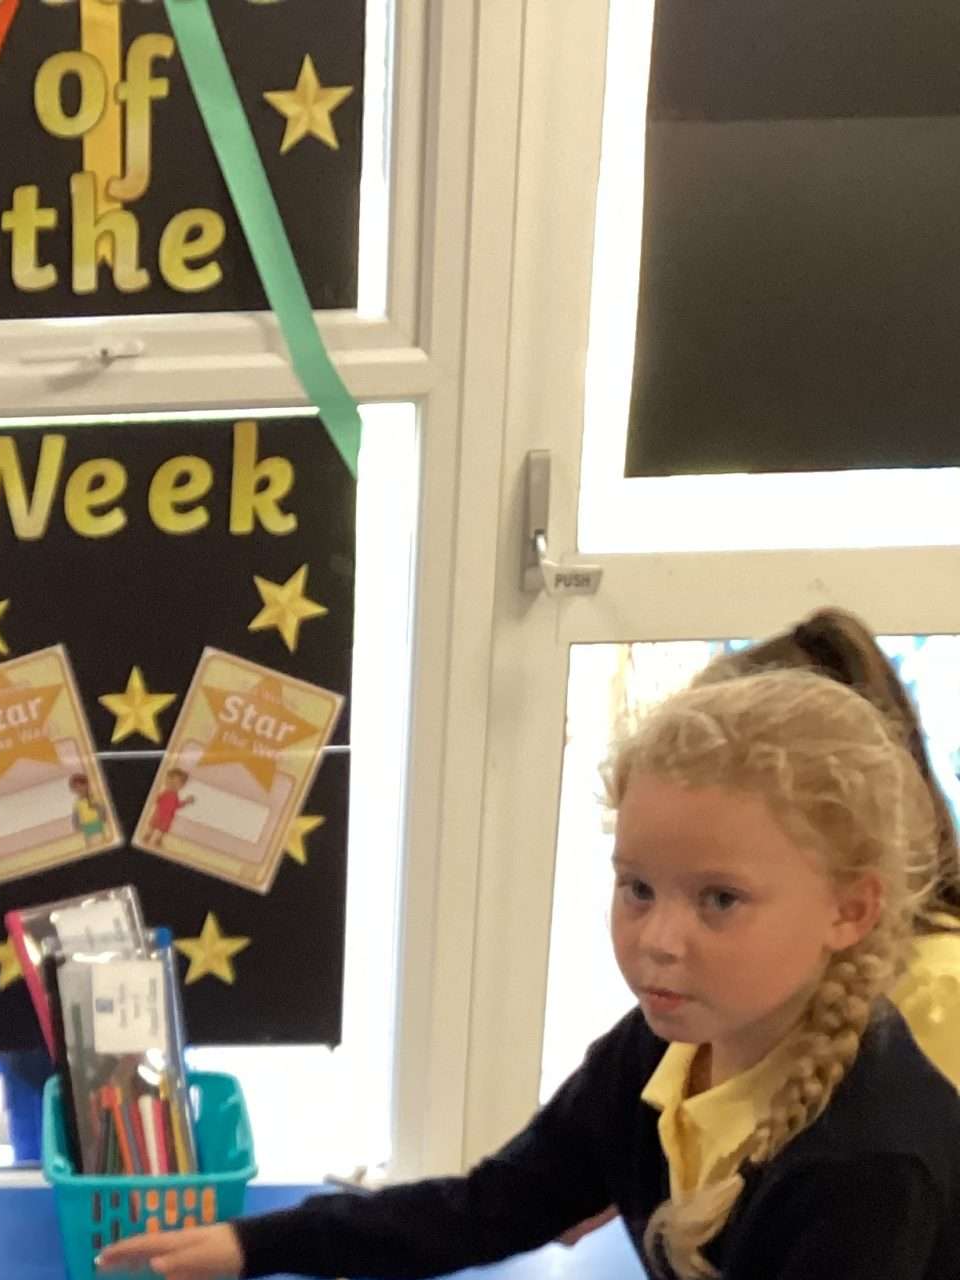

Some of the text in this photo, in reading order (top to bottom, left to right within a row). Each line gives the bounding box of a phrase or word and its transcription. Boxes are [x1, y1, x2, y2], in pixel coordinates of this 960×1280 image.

[33, 33, 175, 200] of
[1, 171, 227, 296] the
[554, 573, 593, 588] PUSH
[218, 693, 297, 743] Star
